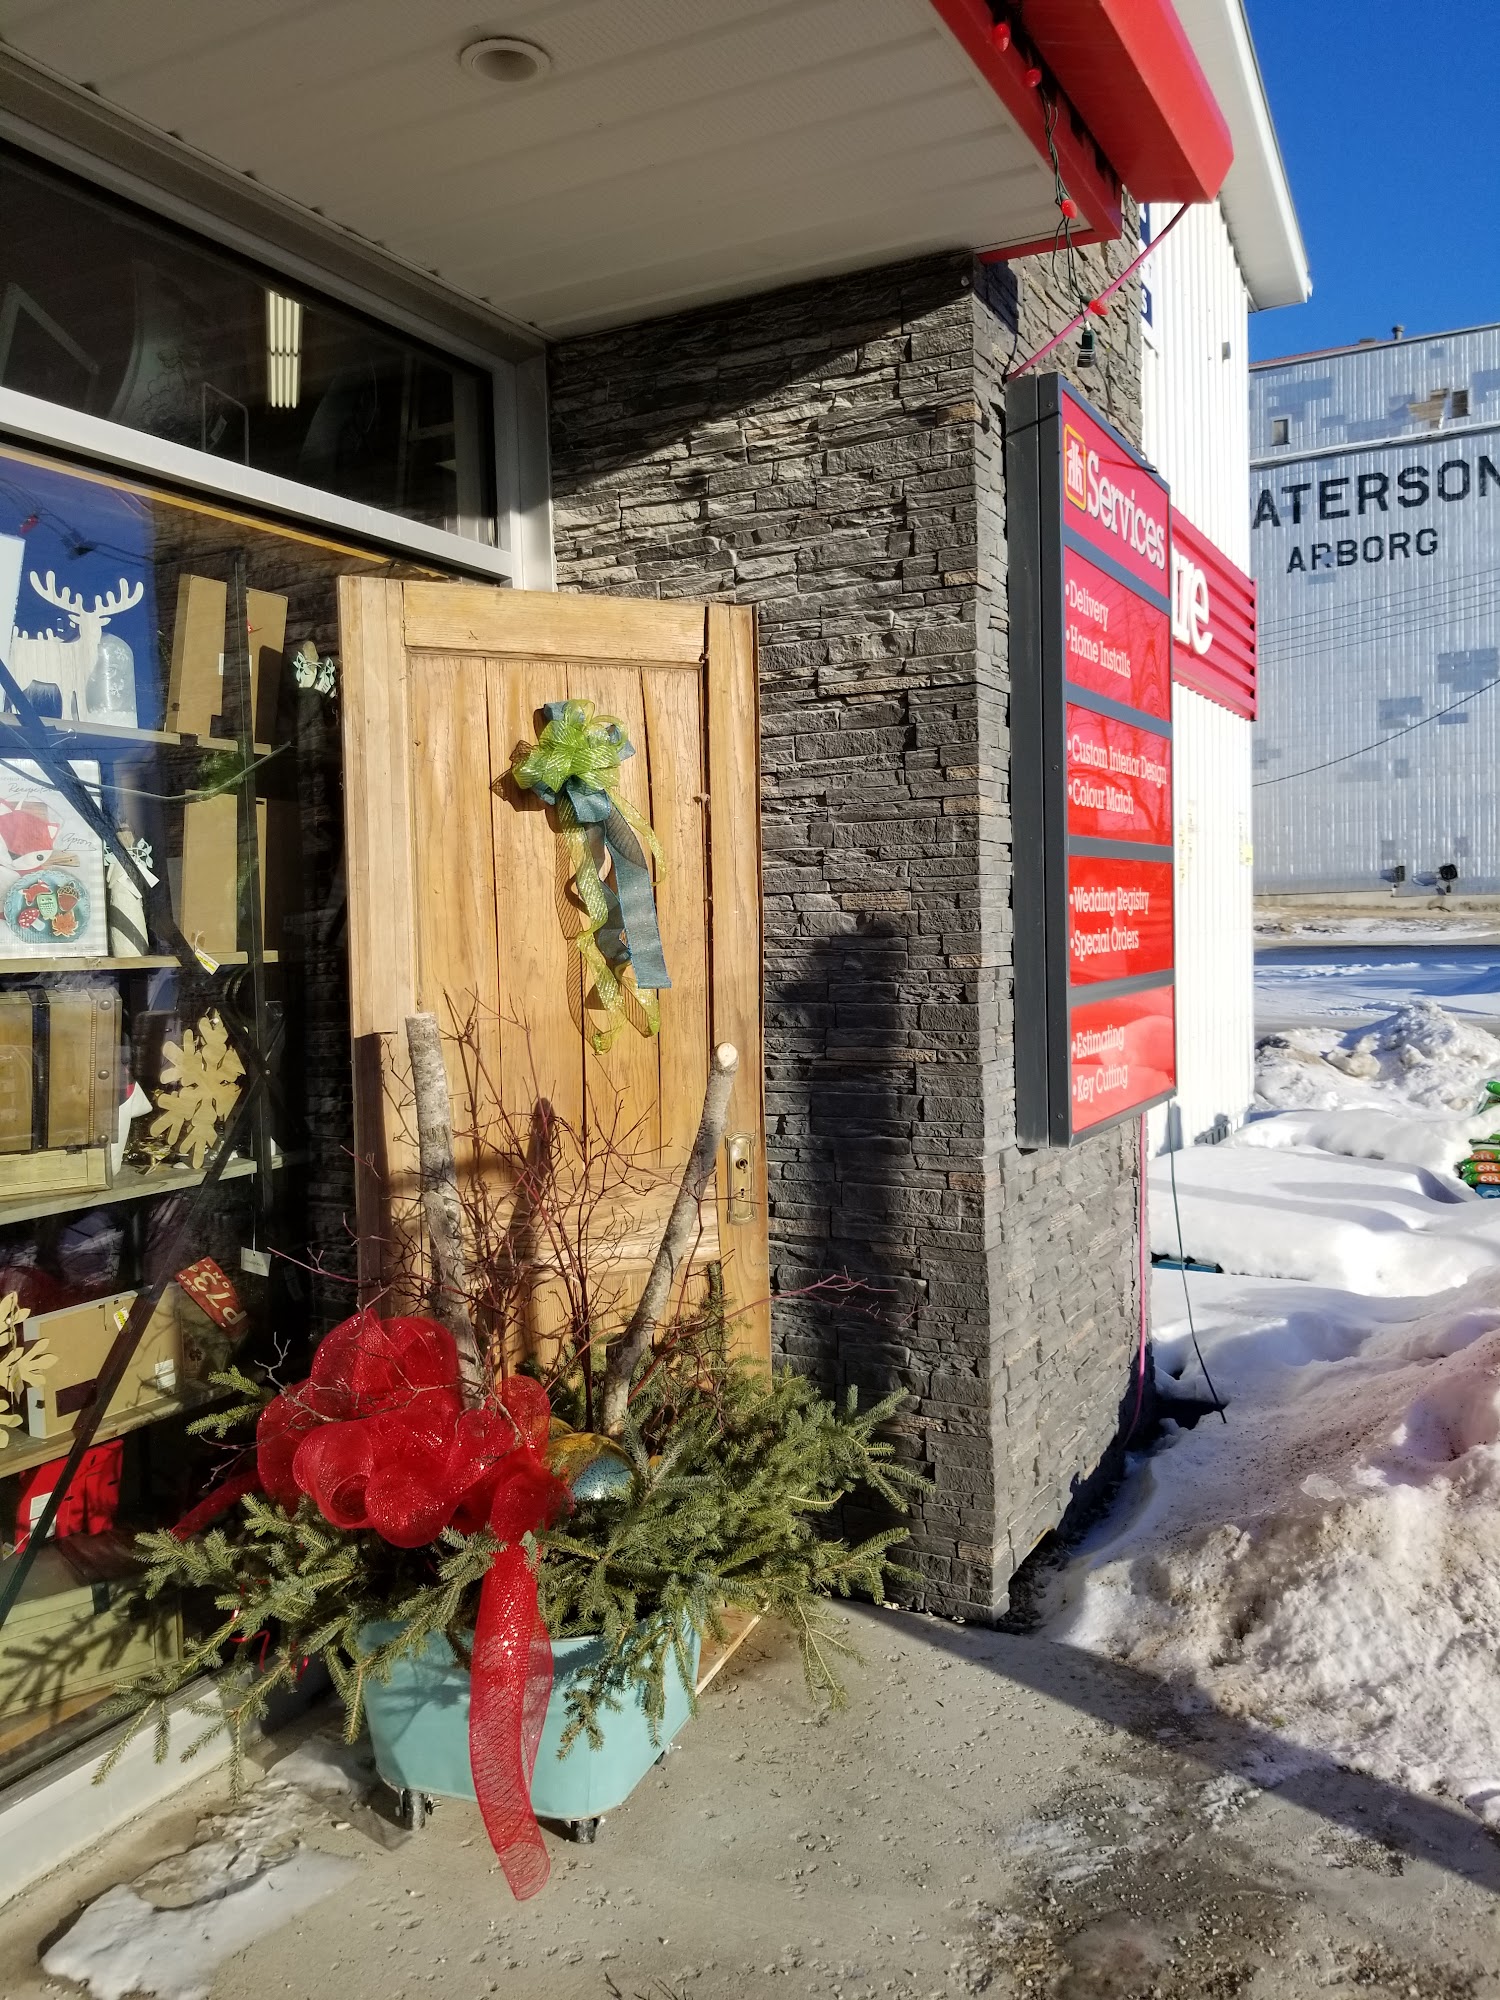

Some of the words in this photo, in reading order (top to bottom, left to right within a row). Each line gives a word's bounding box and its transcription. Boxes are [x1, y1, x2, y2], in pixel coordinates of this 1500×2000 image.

[1087, 450, 1165, 571] Services
[1286, 528, 1439, 574] ARBORG
[1069, 579, 1109, 632] Delivery
[1070, 624, 1099, 664] Home
[1100, 640, 1131, 679] Installs
[1072, 734, 1108, 769] Custom
[1109, 746, 1139, 777] Interior
[1140, 755, 1167, 788] Design
[1072, 778, 1105, 809] Colour
[1105, 786, 1134, 814] Match
[1073, 886, 1116, 917] Wedding
[1116, 886, 1149, 916] Registry
[1074, 928, 1110, 961] Special
[1111, 926, 1139, 952] Orders
[1076, 1024, 1125, 1059] Estimating
[1077, 1075, 1094, 1103] Key
[1096, 1064, 1128, 1094] Cutting
[194, 1271, 247, 1325] P73
